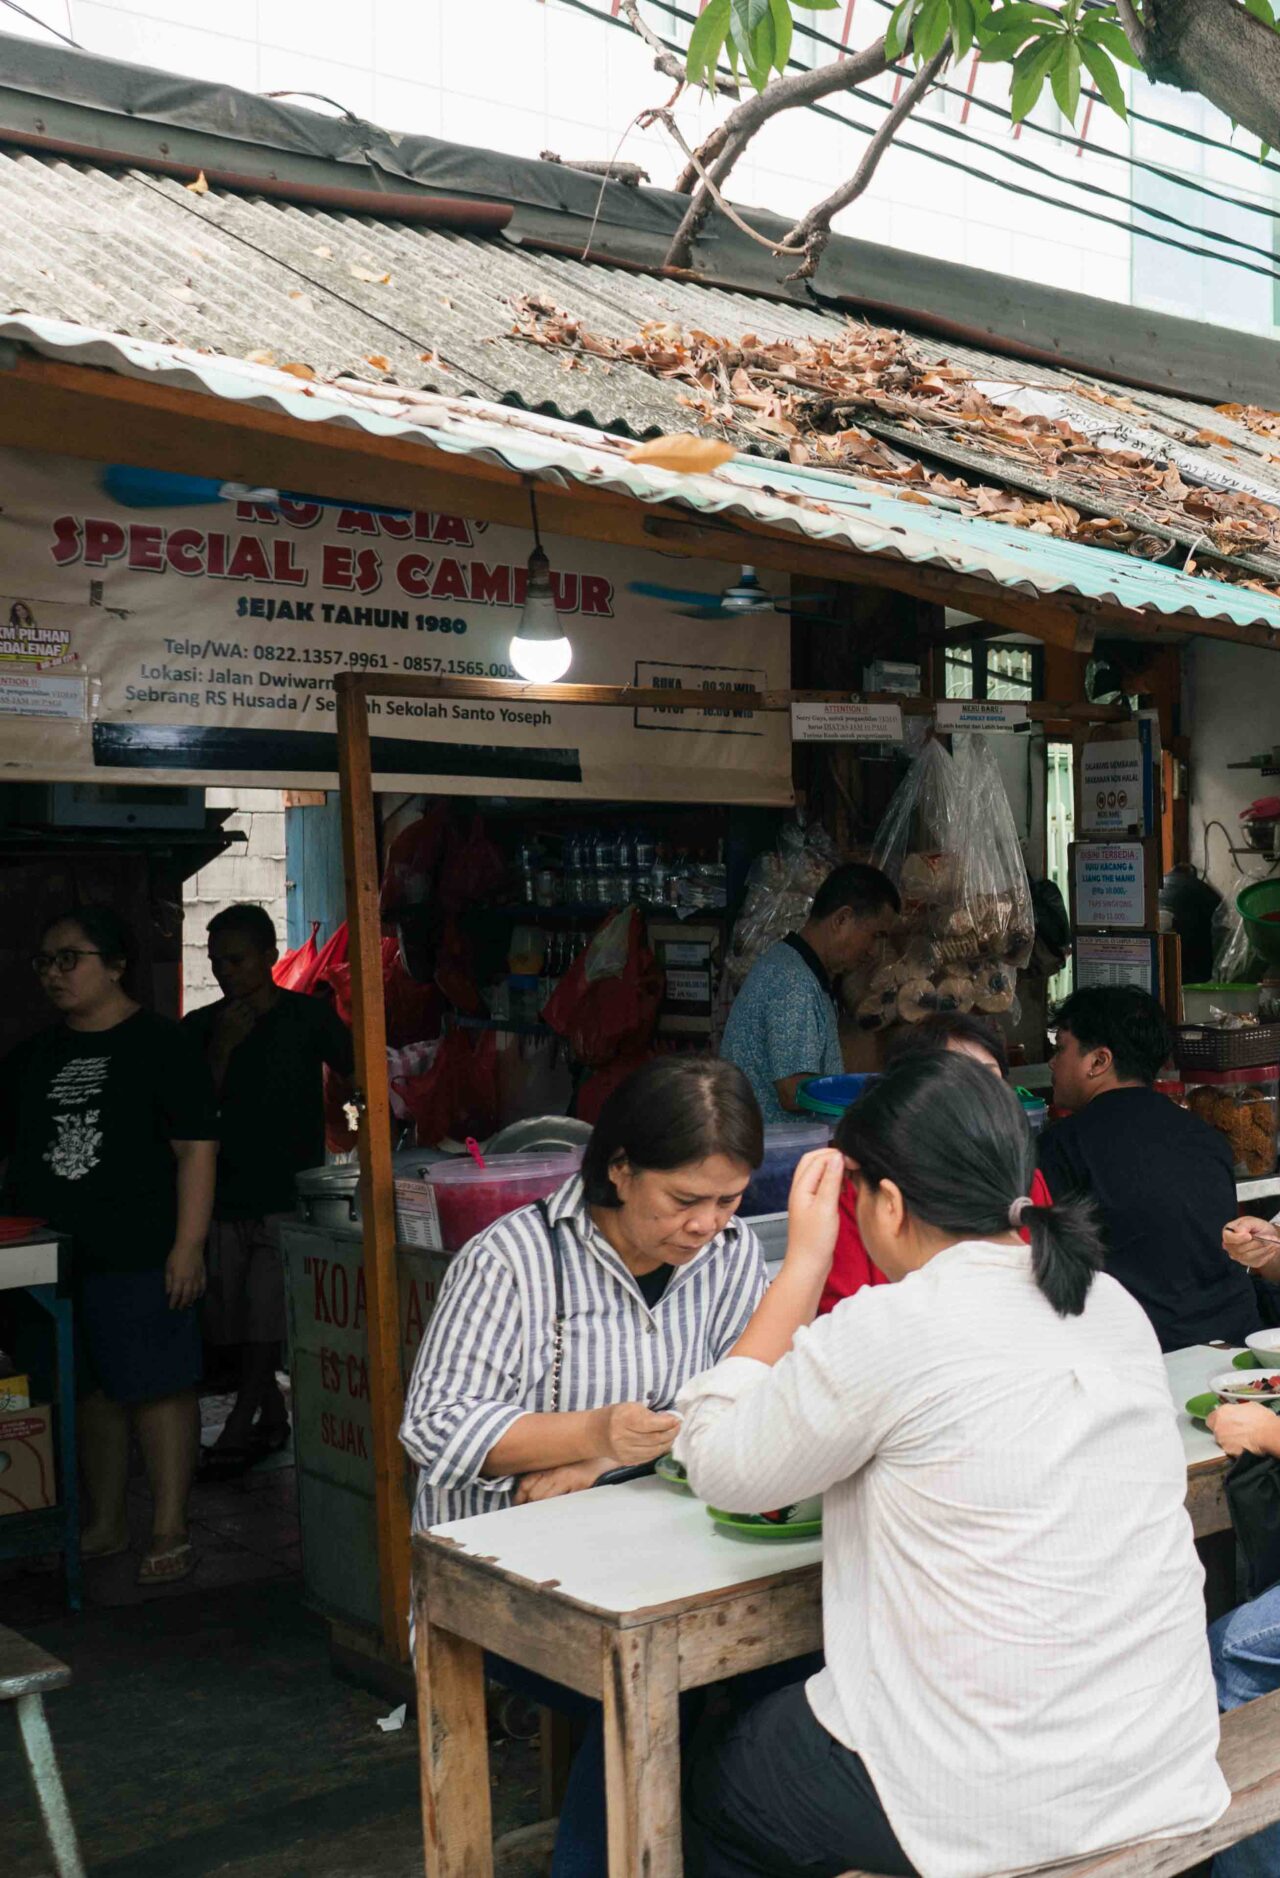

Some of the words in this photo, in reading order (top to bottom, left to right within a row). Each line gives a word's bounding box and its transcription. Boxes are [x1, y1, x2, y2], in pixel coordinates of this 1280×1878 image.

[51, 516, 307, 586] SPECIAL
[322, 544, 382, 595] ES
[237, 596, 314, 623] SEJAK
[322, 605, 410, 630] TAHUN
[416, 614, 468, 634] 1980
[19, 629, 70, 643] PILIHAN
[164, 638, 248, 660] Telp/WA:
[253, 645, 389, 668] 0822.1357.9961
[141, 664, 203, 683] Lokasi:
[208, 668, 253, 686] Jalan
[126, 685, 200, 707] Sebrang
[206, 691, 228, 706] RS
[233, 692, 297, 710] Husada
[824, 705, 860, 713] ATTENTION
[386, 701, 448, 719] Sekolah
[452, 704, 495, 721] Santo
[499, 708, 552, 726] Yoseph
[320, 1346, 341, 1394] ES
[321, 1411, 369, 1460] SEJAK
